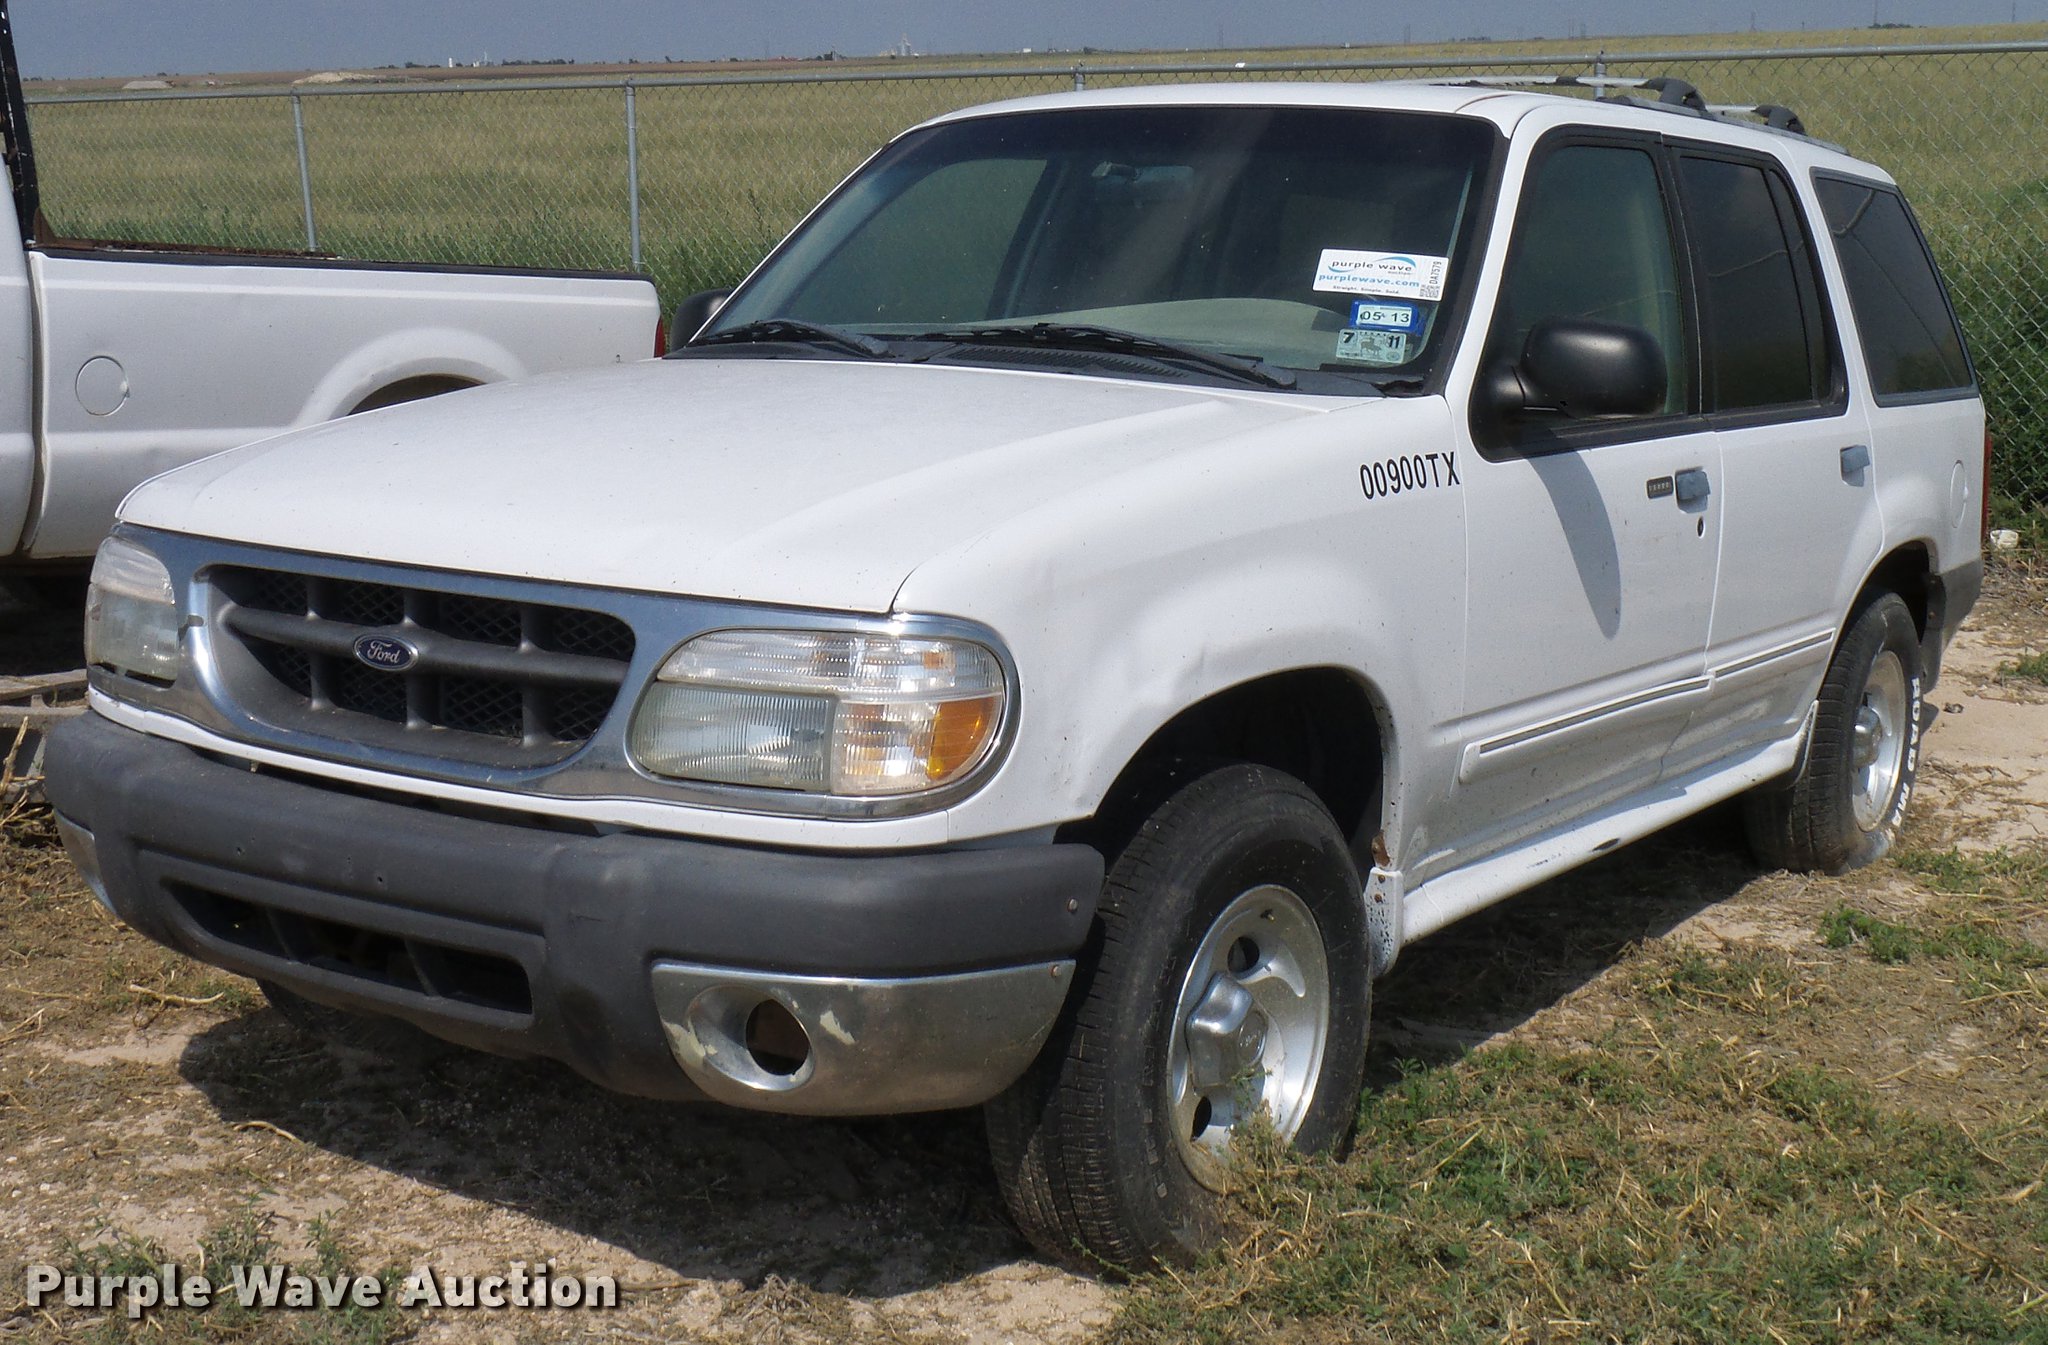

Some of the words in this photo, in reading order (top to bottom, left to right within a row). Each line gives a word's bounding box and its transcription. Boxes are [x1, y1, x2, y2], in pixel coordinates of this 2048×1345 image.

[1332, 261, 1374, 269] purple
[1379, 264, 1412, 272] wave
[1429, 261, 1442, 285] DA7579
[1318, 274, 1420, 288] purplewave.com
[1391, 312, 1410, 323] 13
[1343, 332, 1355, 344] 7
[1388, 335, 1401, 349] 11
[1360, 451, 1460, 500] 00900TX
[367, 640, 401, 664] Ford
[1907, 677, 1921, 772] ROAD
